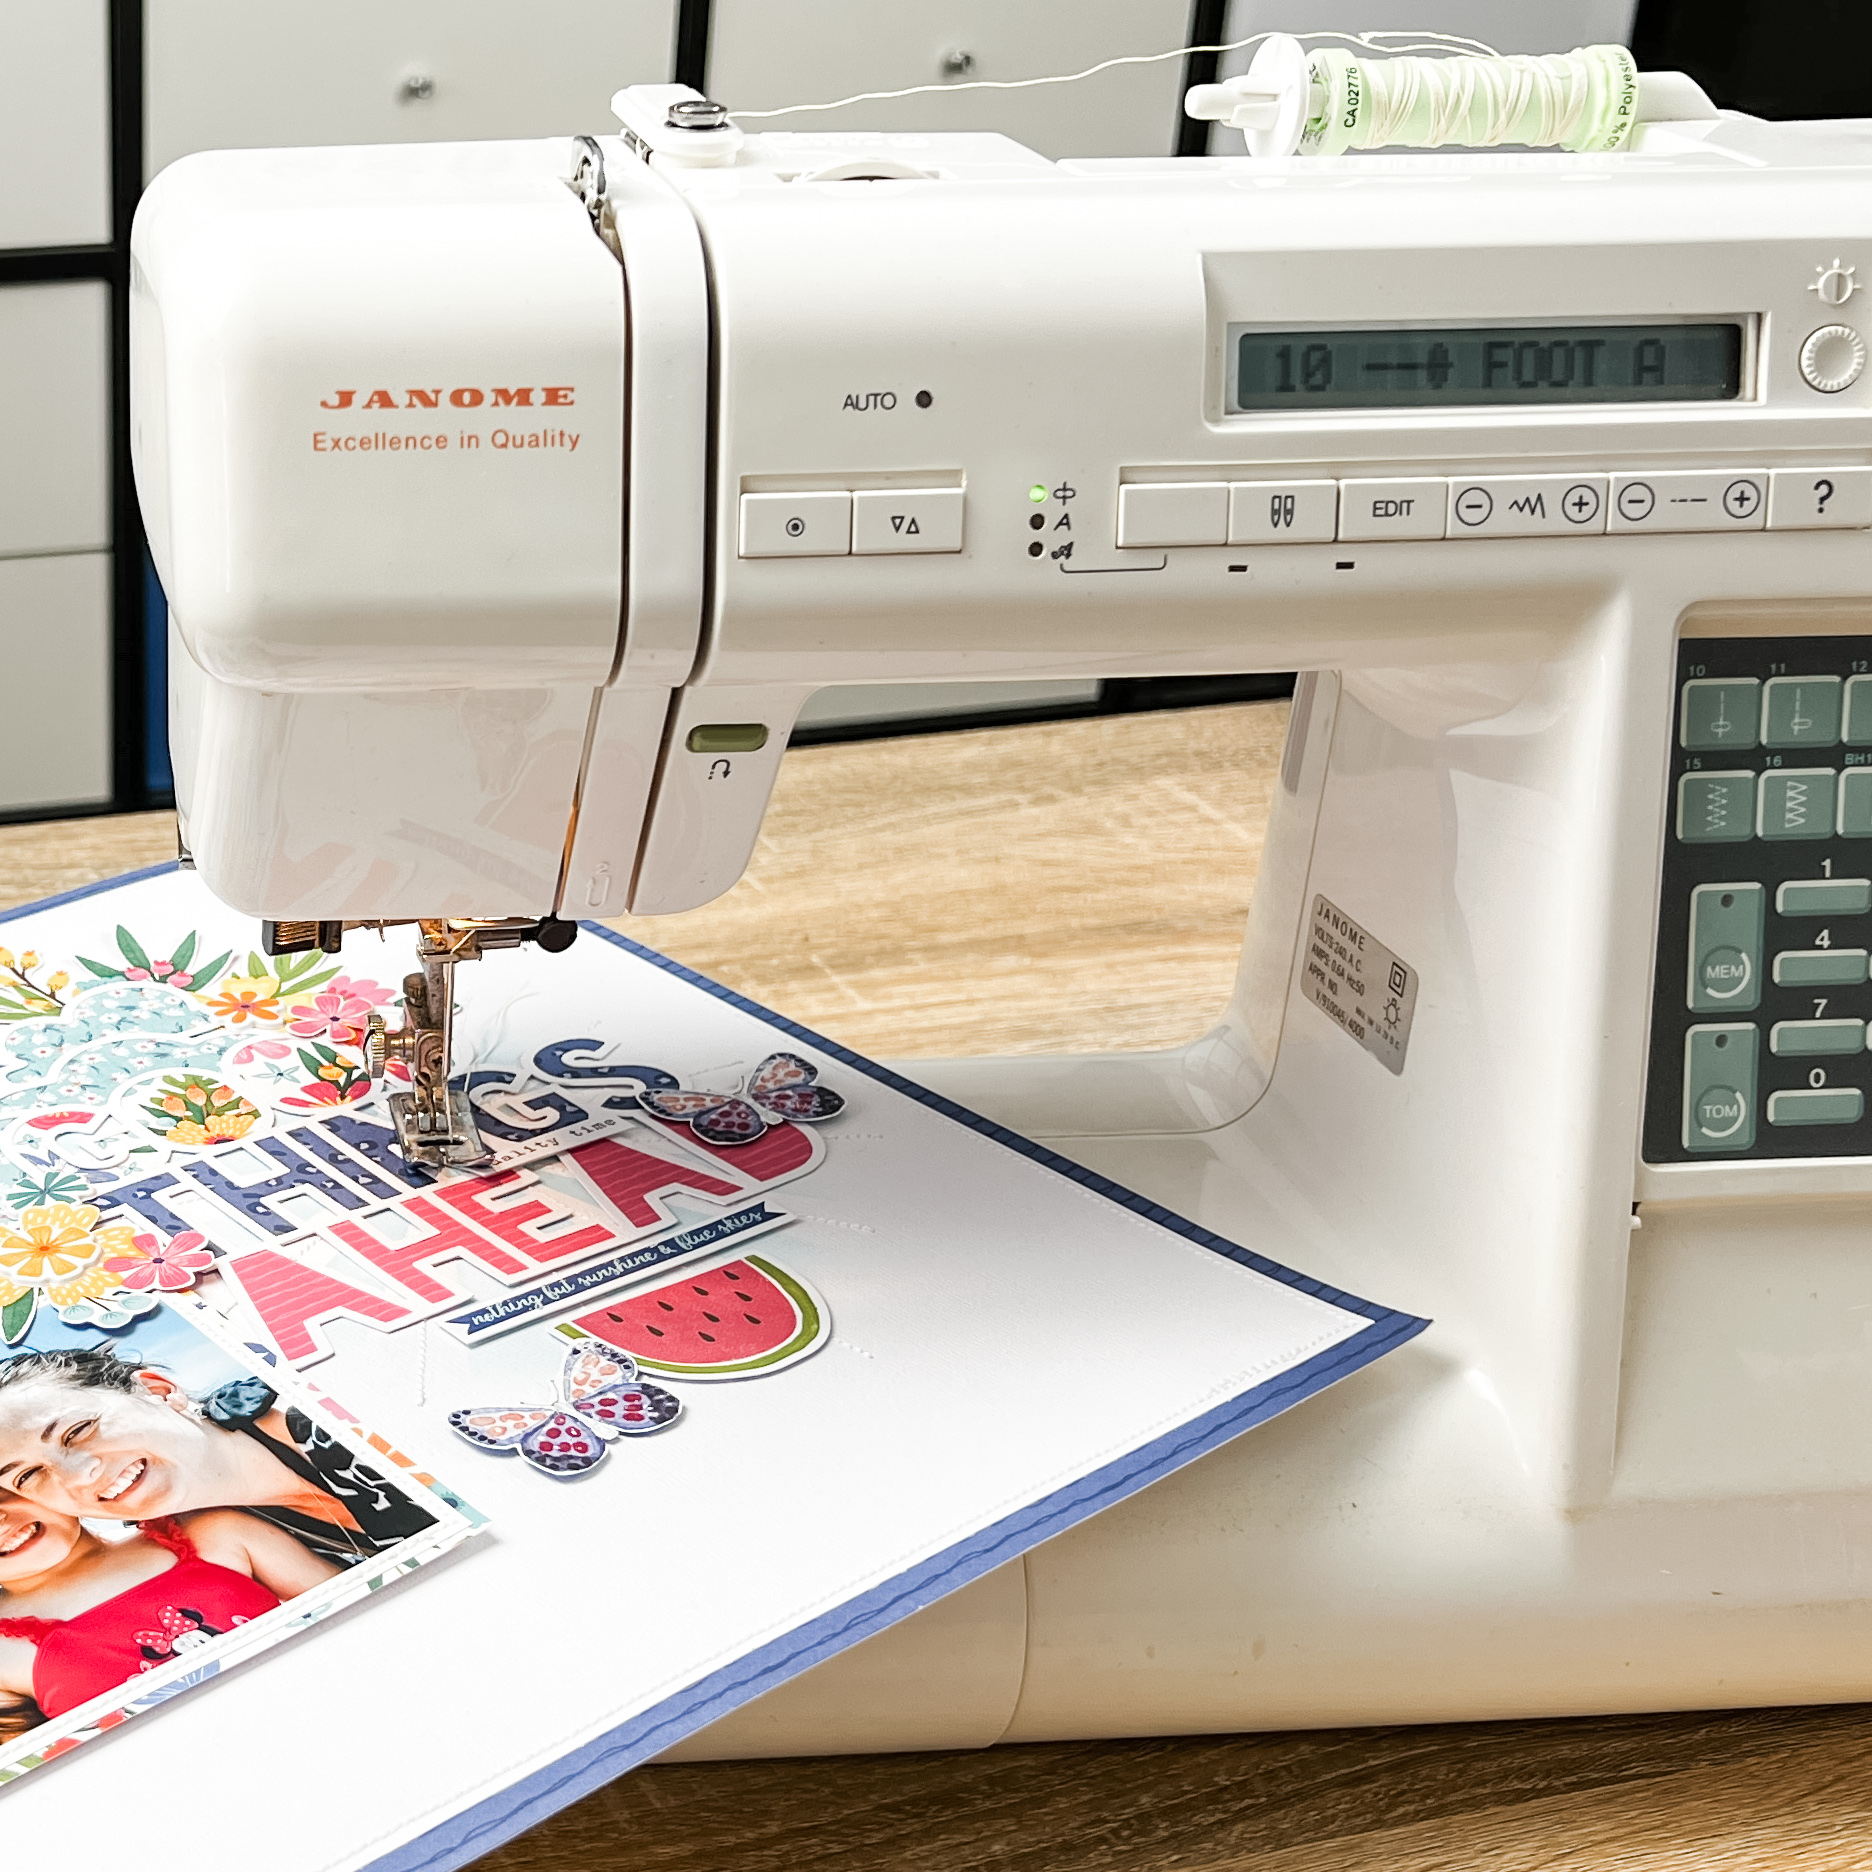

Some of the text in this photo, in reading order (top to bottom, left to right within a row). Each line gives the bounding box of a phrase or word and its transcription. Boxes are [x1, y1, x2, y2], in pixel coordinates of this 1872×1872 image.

[1615, 52, 1636, 116] Polyester
[1274, 338, 1666, 393] 10 FOOT A
[320, 386, 575, 410] JANOME
[842, 392, 898, 411] AUTO
[312, 429, 580, 452] Excellence in Quality
[1813, 479, 1834, 513] ?
[1373, 498, 1415, 518] EDIT
[1054, 513, 1072, 531] A
[1688, 665, 1706, 677] 10
[1770, 663, 1787, 675] 11
[1851, 660, 1869, 673] 12
[1685, 758, 1702, 770] 15
[1766, 755, 1783, 767] 16
[1820, 858, 1832, 879] 1
[1316, 902, 1367, 952] JANOME
[1814, 928, 1831, 949] 4
[1706, 964, 1744, 980] MEM
[1812, 998, 1828, 1018] 7
[1808, 1067, 1827, 1088] 0
[1702, 1104, 1738, 1119] TOM
[569, 1118, 616, 1137] time
[229, 1113, 814, 1362] AHEAD
[471, 1211, 764, 1326] nothing but sunshine & blue skies
